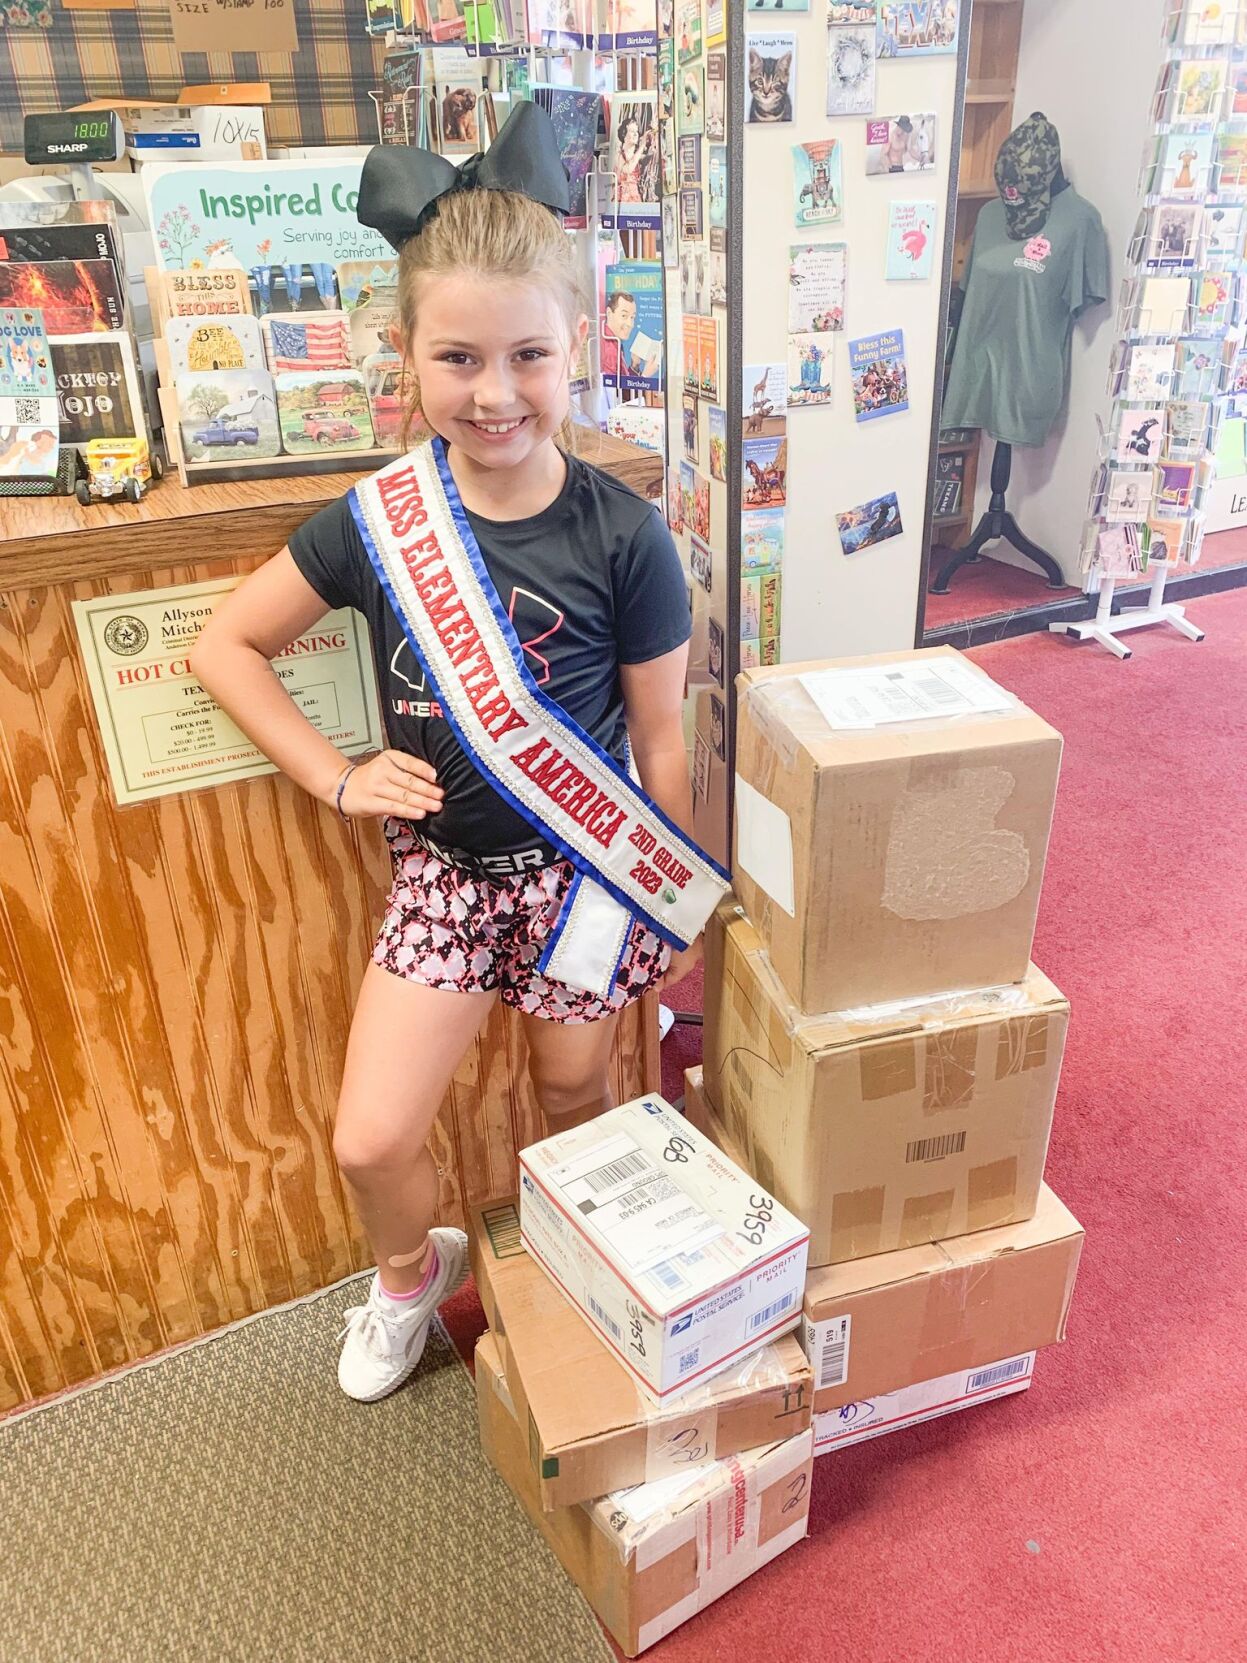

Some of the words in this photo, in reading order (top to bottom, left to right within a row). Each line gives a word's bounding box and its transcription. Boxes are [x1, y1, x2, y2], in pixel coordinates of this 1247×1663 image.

[177, 3, 209, 13] SIZE
[626, 36, 654, 45] Birthday
[47, 143, 88, 154] SHARP
[200, 183, 323, 226] Inspired
[626, 219, 652, 229] Birthday
[96, 233, 109, 256] MOJO
[283, 228, 334, 247] Serving
[338, 230, 358, 249] joy
[334, 245, 385, 260] comfort
[173, 275, 237, 292] BLESS
[177, 301, 241, 316] HOME
[15, 326, 43, 337] LOVE
[853, 350, 879, 363] Funny
[880, 343, 901, 356] Farm!
[858, 340, 879, 352] Bless
[880, 335, 896, 346] this
[626, 380, 652, 390] Birthday
[376, 464, 428, 538] MISS
[162, 607, 213, 622] Allyson
[161, 621, 204, 638] Mitch
[400, 532, 529, 744] ELEMENTARY
[275, 632, 347, 658] RNING
[117, 663, 164, 686] HOT
[182, 685, 206, 696] TEX
[177, 708, 200, 717] Carries
[302, 699, 319, 707] JAIL:
[170, 721, 194, 732] CHECK
[142, 771, 160, 779] THIS
[161, 758, 226, 775] ESTABLISHMENT
[509, 736, 628, 850] AMERICA
[628, 824, 658, 851] 2ND
[629, 859, 664, 895] 2023
[653, 845, 695, 891] GRADE
[704, 1153, 741, 1185] PRIORITY
[706, 1163, 723, 1180] MAIL
[735, 1194, 774, 1246] 3959
[756, 1250, 800, 1282] PRIORITY
[766, 1268, 788, 1283] MAIL
[692, 1308, 719, 1326] POSTAL
[718, 1292, 745, 1310] SERVICE
[694, 1297, 721, 1316] UNITED
[718, 1285, 743, 1302] STATES
[625, 1298, 647, 1357] 3959
[815, 1427, 848, 1442] TRACKED
[852, 1416, 884, 1431] INSURED
